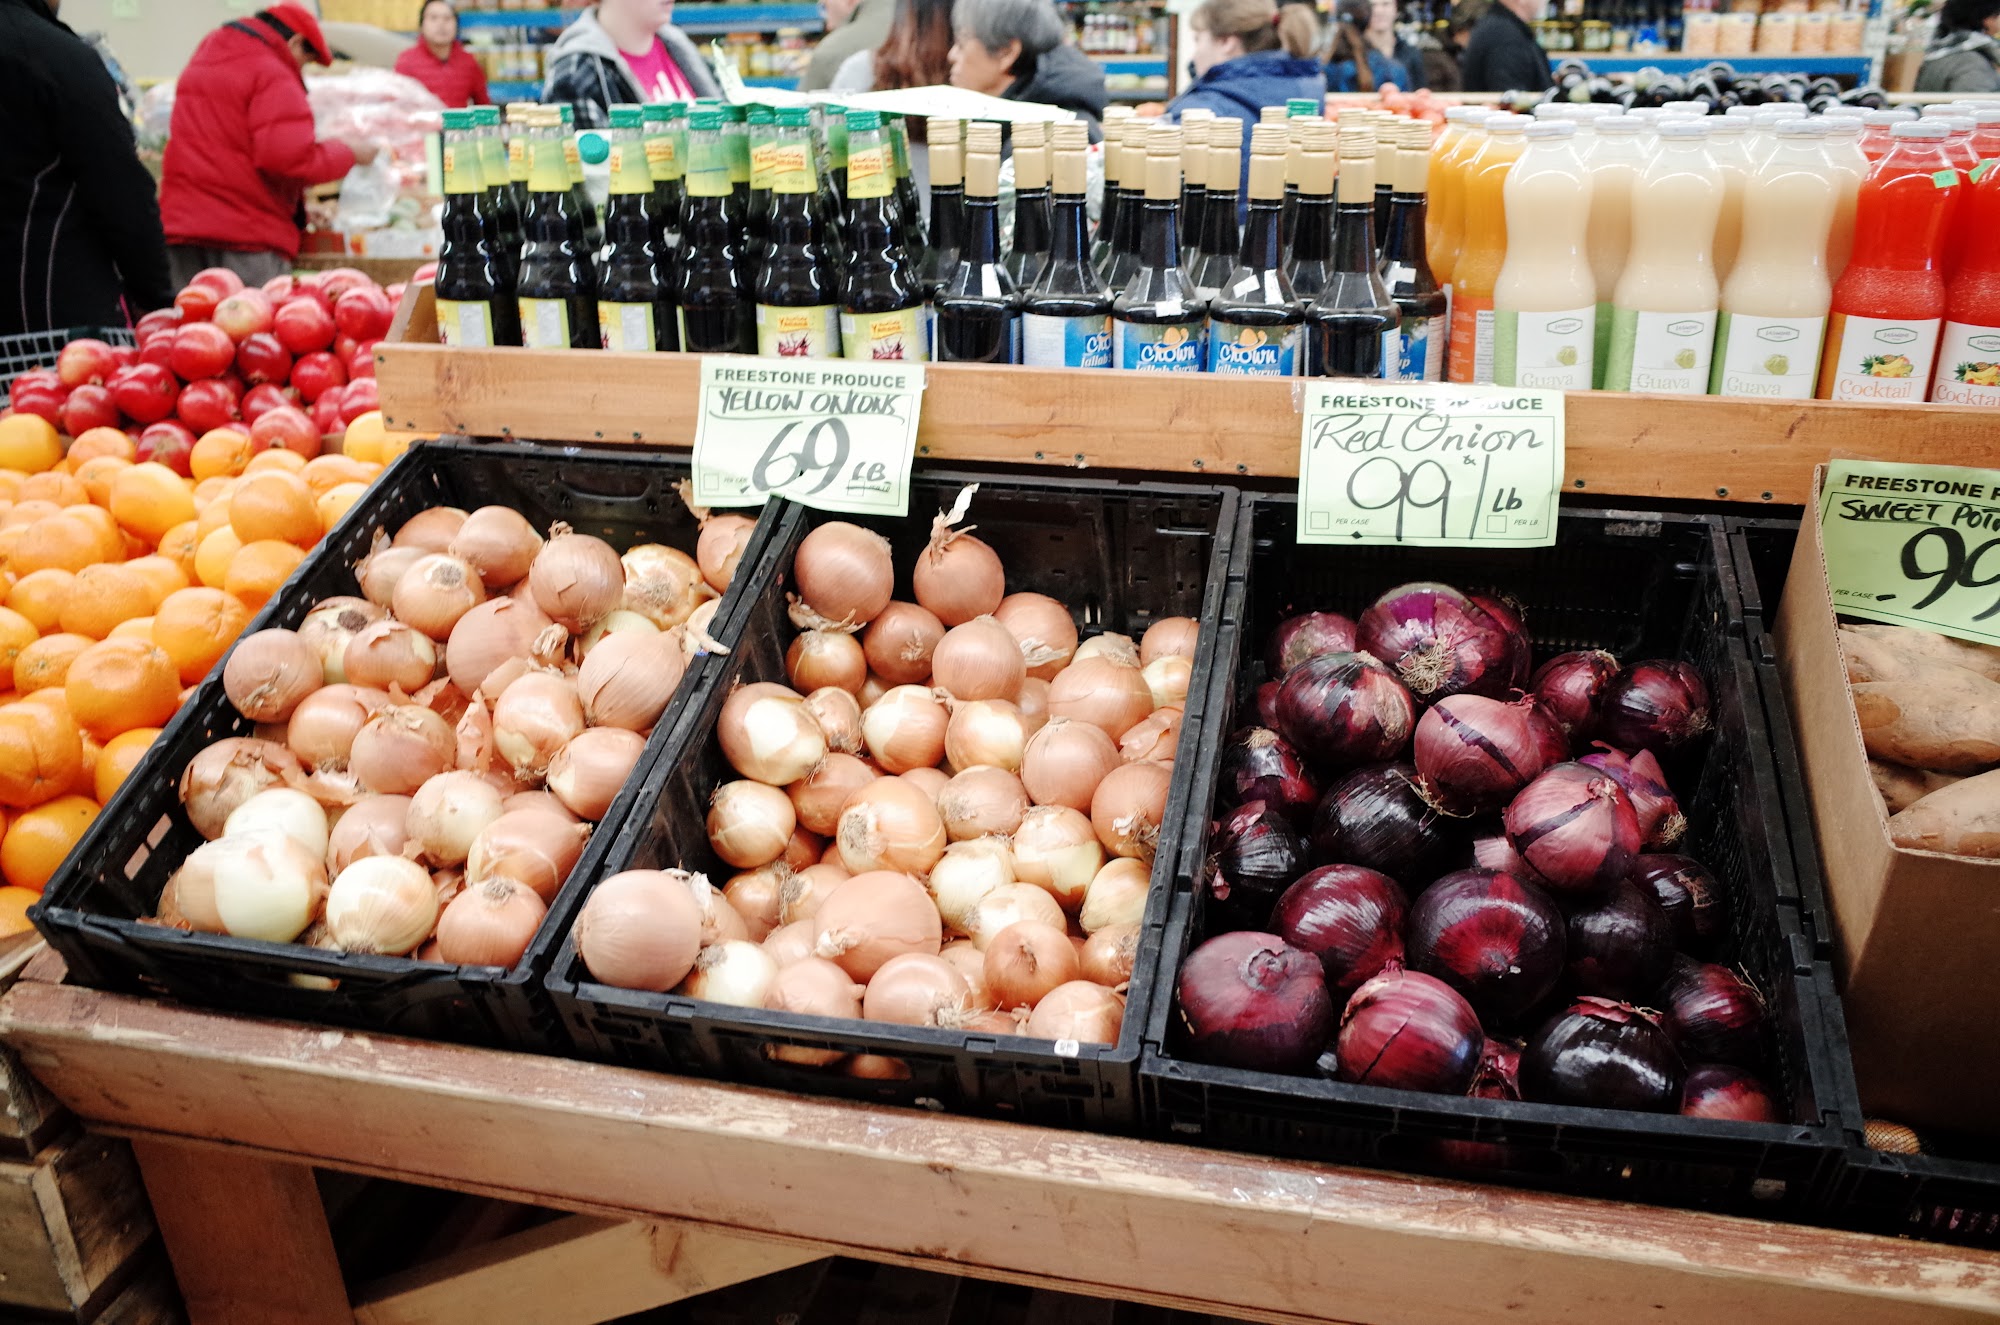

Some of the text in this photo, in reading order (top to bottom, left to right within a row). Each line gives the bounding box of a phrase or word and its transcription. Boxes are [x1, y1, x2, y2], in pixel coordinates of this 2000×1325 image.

[715, 368, 906, 389] FREESTONE PRODUCE
[1521, 373, 1574, 388] Guava
[1637, 373, 1691, 390] Guava
[1726, 376, 1782, 395] Guava
[1839, 379, 1912, 398] Cocktail
[1936, 384, 2000, 405] Cockta
[719, 387, 803, 414] YELLOW
[1321, 395, 1436, 410] FREESTONE
[1313, 407, 1545, 453] Red Onion
[852, 462, 886, 481] LB
[1844, 474, 1985, 498] FREESTONE
[1838, 499, 1944, 521] SWEET
[1851, 591, 1874, 600] CASE
